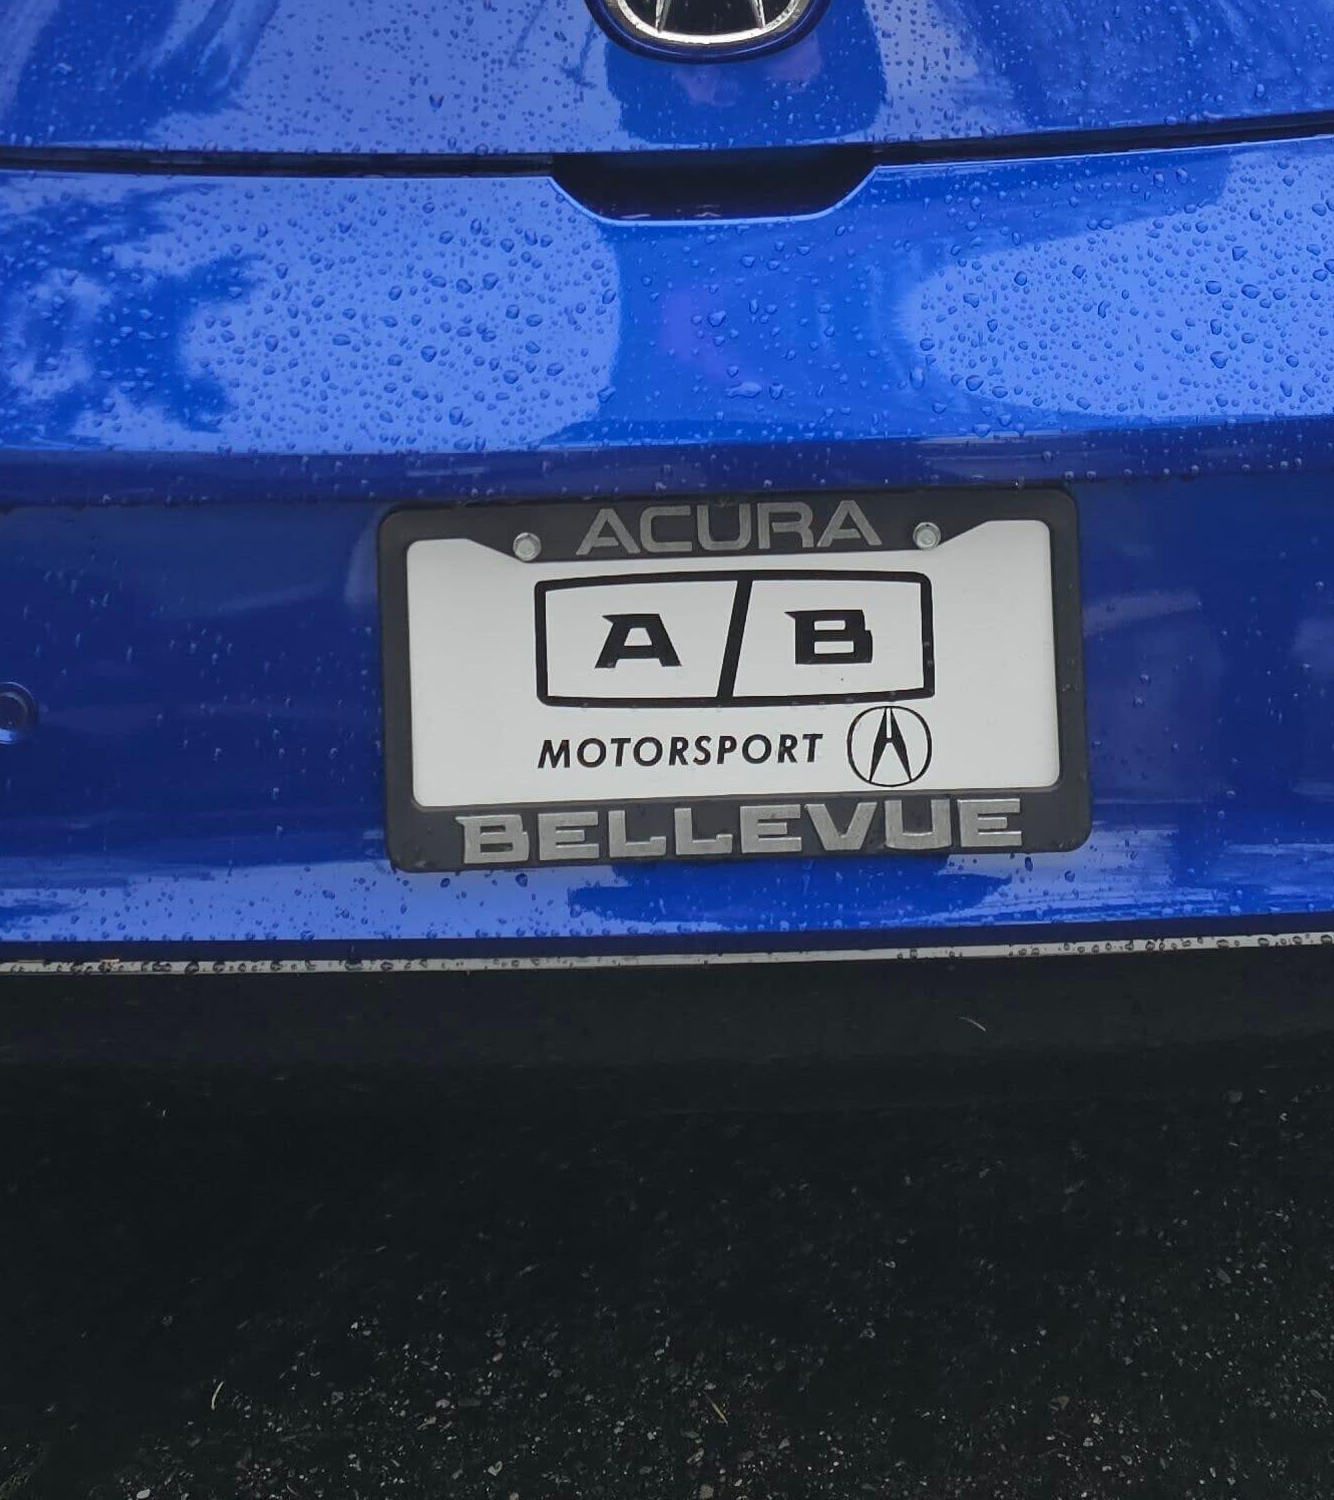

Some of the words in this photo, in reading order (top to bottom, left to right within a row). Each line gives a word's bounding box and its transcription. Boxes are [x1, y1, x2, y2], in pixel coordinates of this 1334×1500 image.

[575, 500, 882, 556] ACURA
[594, 613, 682, 668] A
[784, 609, 873, 664] B
[536, 733, 824, 769] MOTORSPORT
[455, 798, 1023, 864] BELLEVUE
